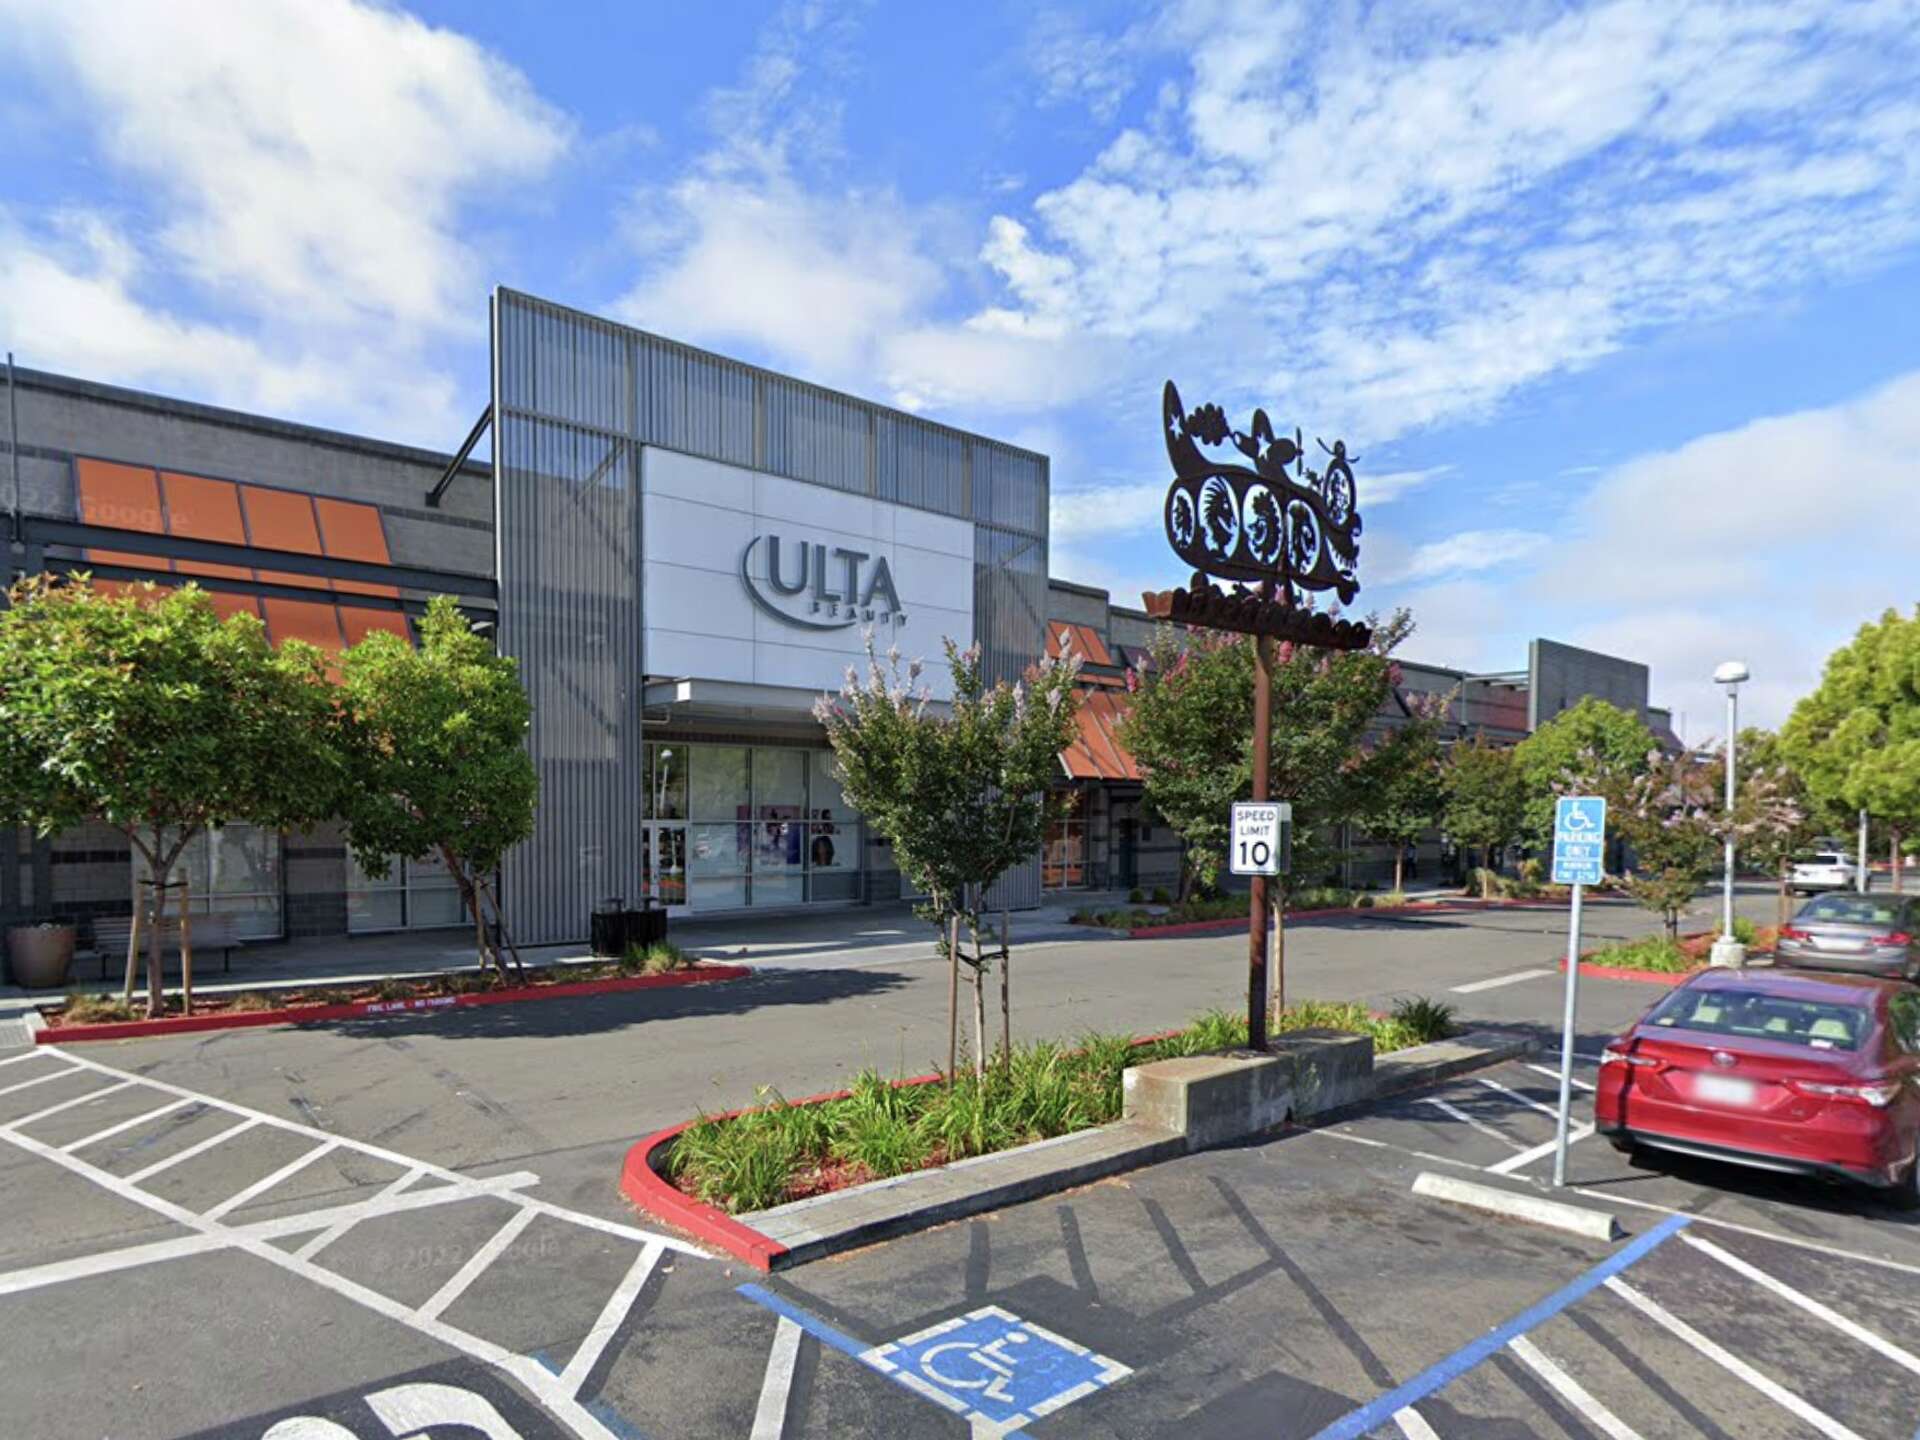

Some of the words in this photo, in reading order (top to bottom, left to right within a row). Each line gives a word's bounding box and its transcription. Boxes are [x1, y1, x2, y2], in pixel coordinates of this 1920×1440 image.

[768, 534, 902, 613] ULTA
[810, 601, 907, 627] BEAUTY
[1237, 810, 1275, 821] SPEED
[1240, 825, 1270, 836] LIMIT
[1239, 841, 1270, 866] 10
